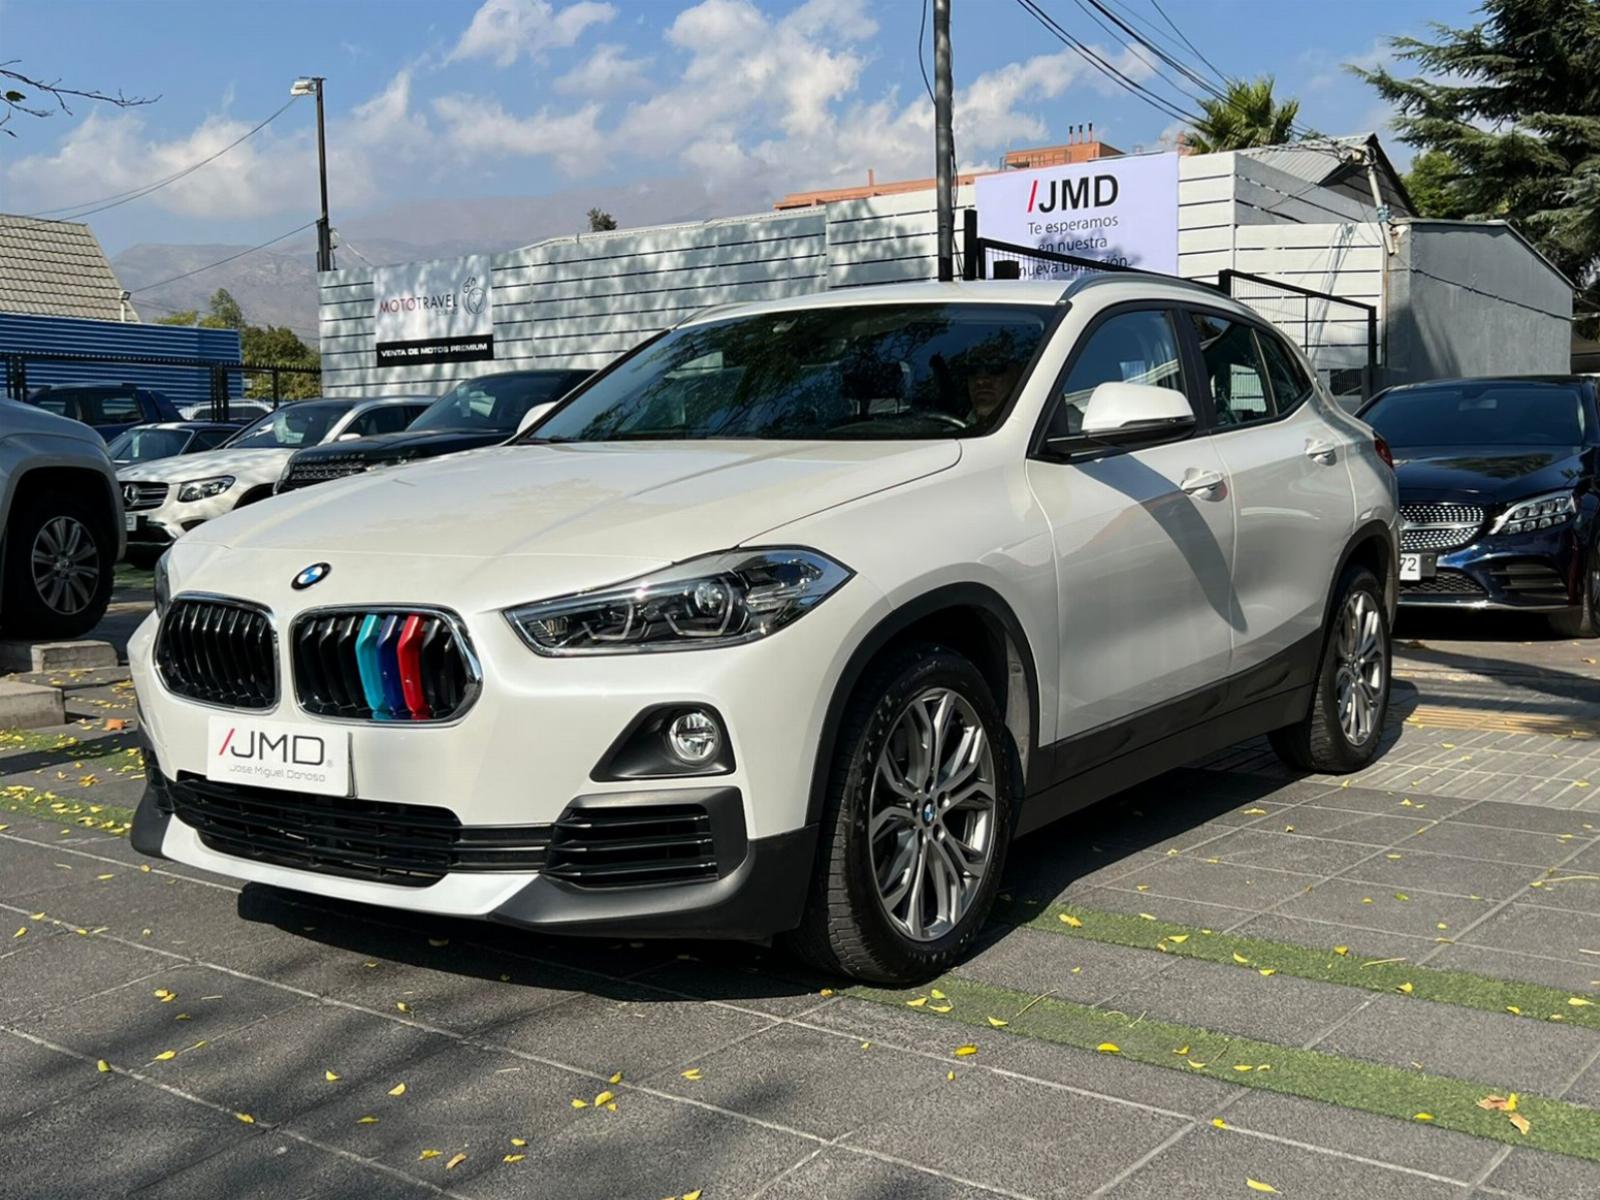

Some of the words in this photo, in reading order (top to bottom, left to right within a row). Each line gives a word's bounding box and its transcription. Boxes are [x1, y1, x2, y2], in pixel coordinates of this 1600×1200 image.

[1027, 222, 1042, 235] Te
[1045, 216, 1119, 235] esperamos
[1038, 243, 1054, 252] en
[1057, 237, 1108, 252] nuestra
[381, 349, 407, 358] VENTA
[408, 348, 420, 356] DE
[420, 346, 449, 355] MOTOS
[450, 343, 488, 352] PREMIUM
[254, 766, 285, 778] Miguel
[286, 769, 326, 782] Donoso
